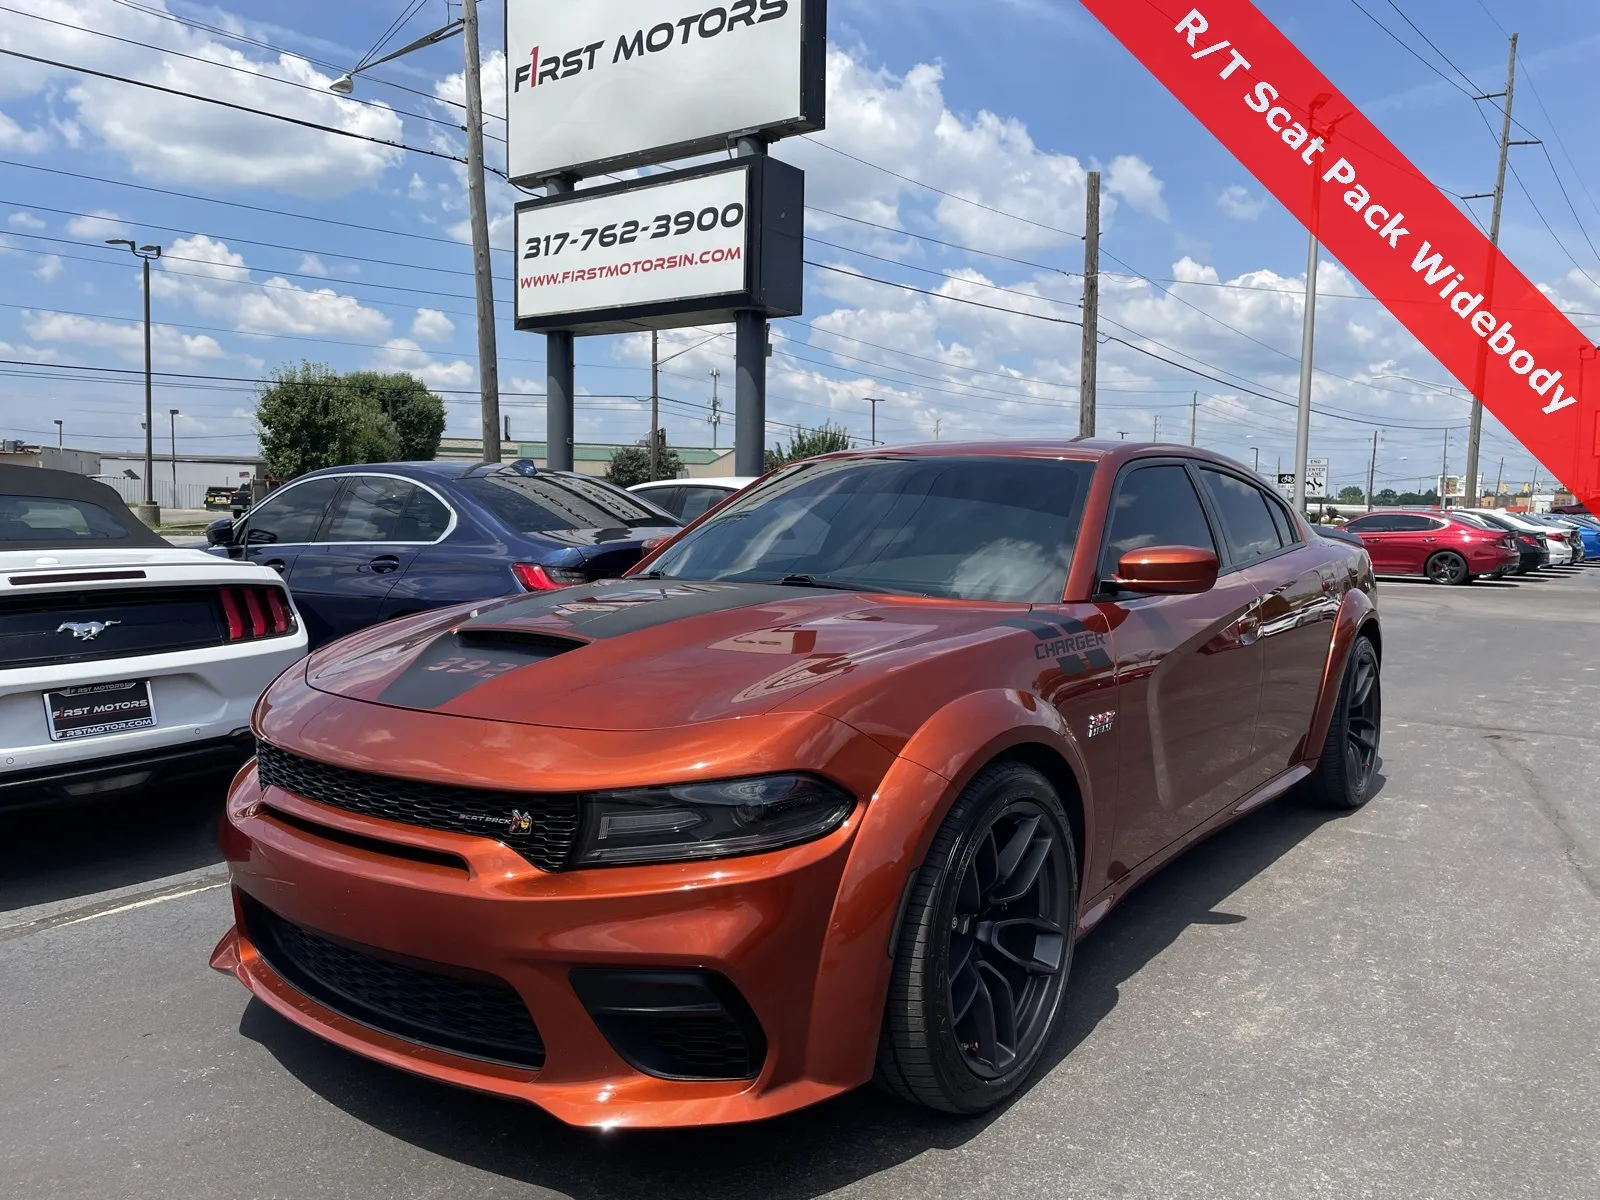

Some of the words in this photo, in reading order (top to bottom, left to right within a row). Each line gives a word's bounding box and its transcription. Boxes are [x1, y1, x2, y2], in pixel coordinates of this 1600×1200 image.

[611, 0, 789, 64] MOTORS
[523, 202, 744, 260] 317-762-3900
[520, 247, 741, 289] WWW.FIRSTMOTORSIN.COM
[1034, 633, 1106, 660] CHARGER
[93, 682, 126, 691] MOTORS
[93, 699, 148, 713] MOTORS
[458, 813, 485, 821] SCAT
[485, 815, 512, 825] PACK
